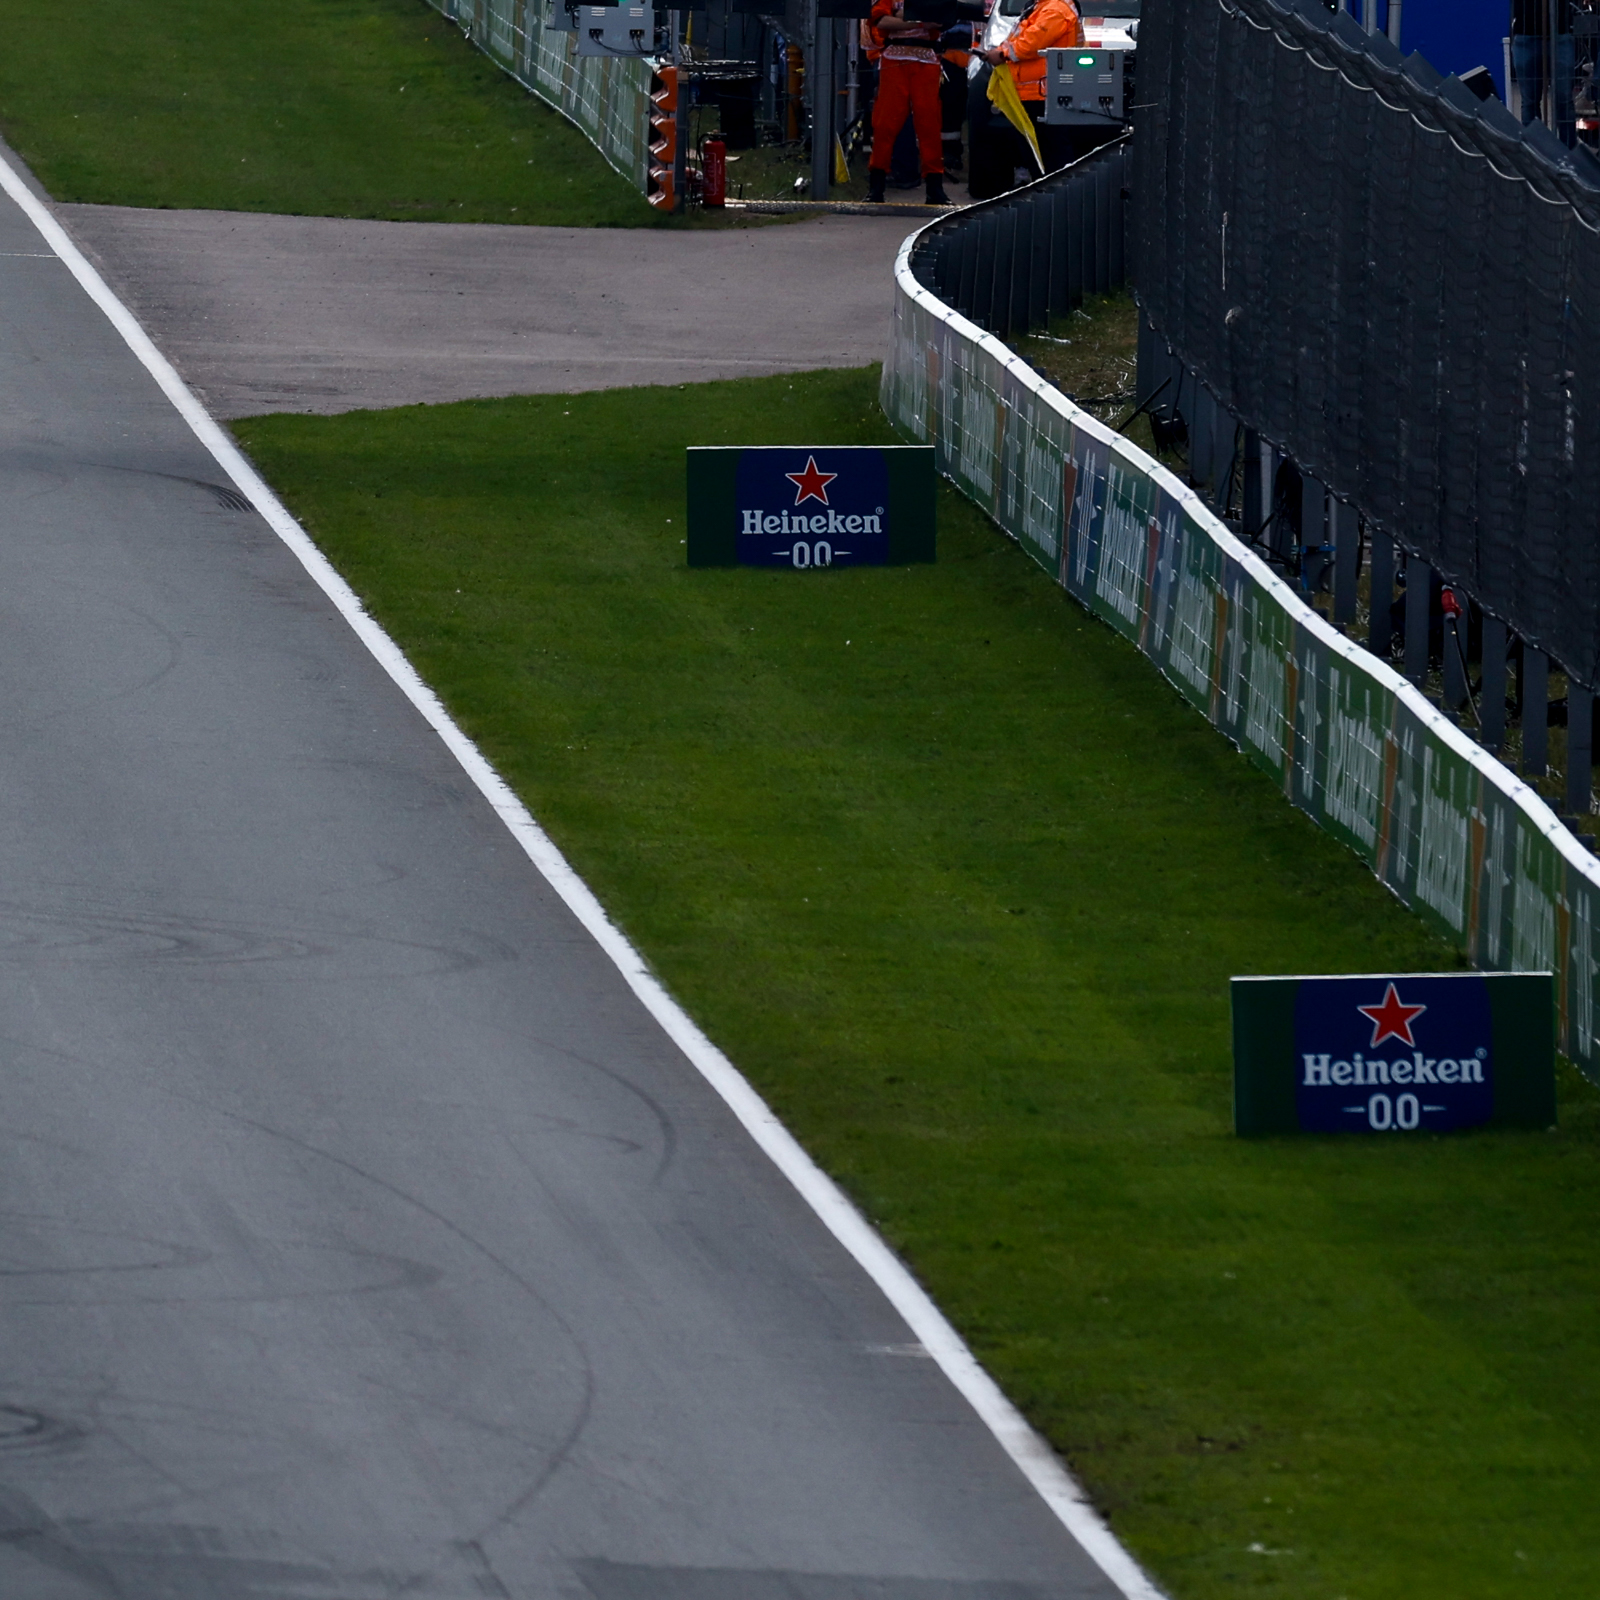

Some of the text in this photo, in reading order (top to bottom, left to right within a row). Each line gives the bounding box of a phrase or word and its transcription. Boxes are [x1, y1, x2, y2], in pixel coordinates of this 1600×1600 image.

[742, 508, 883, 534] Heineken
[1303, 1051, 1485, 1086] Heineken
[1368, 1093, 1420, 1131] 0.0
